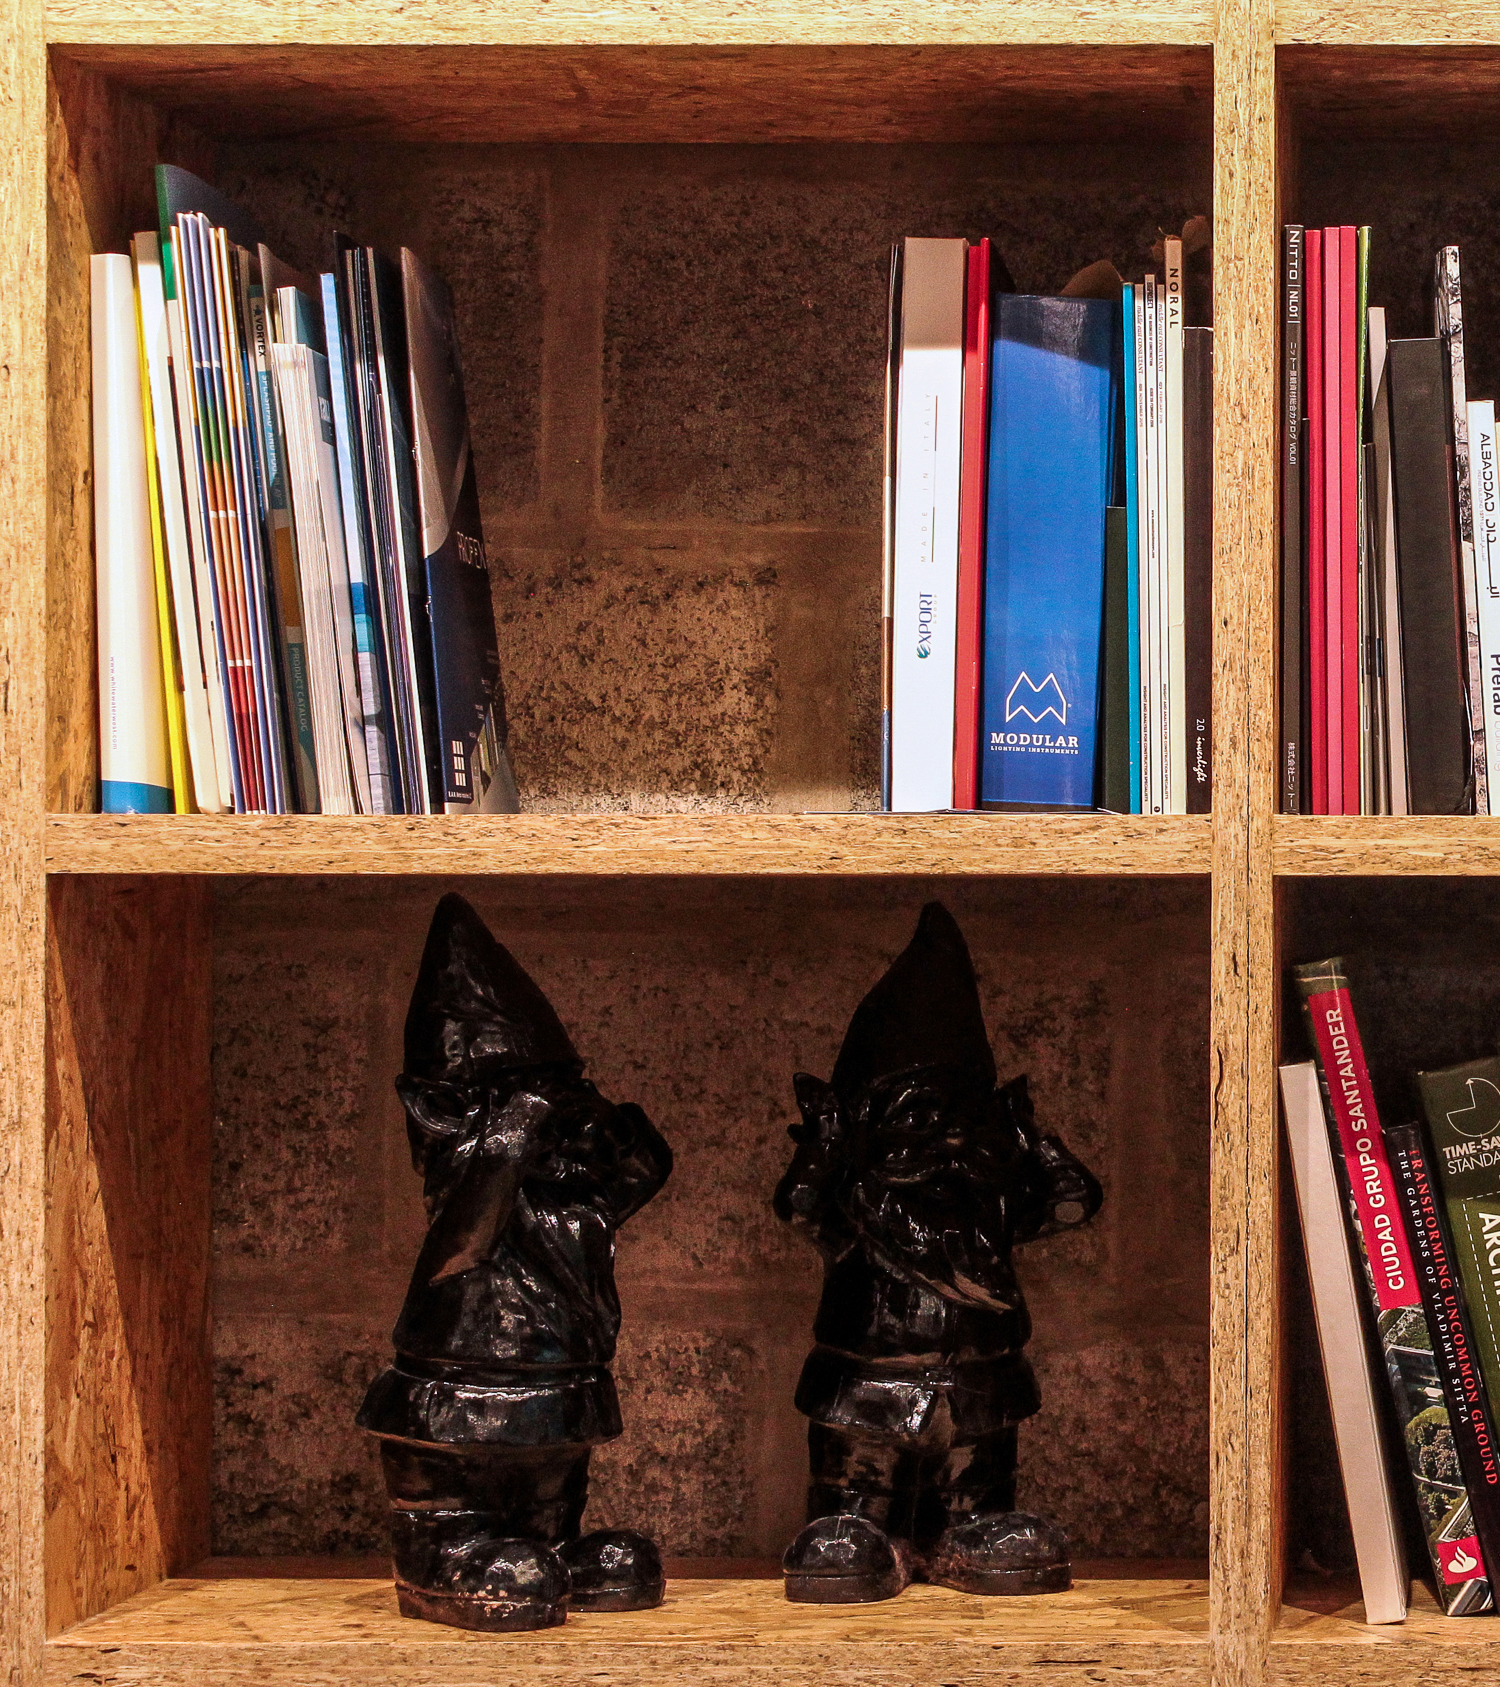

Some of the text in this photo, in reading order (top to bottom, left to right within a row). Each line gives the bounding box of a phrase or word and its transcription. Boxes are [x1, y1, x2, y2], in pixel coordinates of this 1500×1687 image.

[1169, 267, 1180, 330] NORAL
[1288, 229, 1301, 318] NITTO NL01
[254, 317, 267, 358] VORTEX
[920, 393, 931, 562] MADE IN ITALY
[1480, 432, 1496, 513] ALBADDAD
[290, 647, 309, 733] PRODUCT CATALOG
[1196, 718, 1206, 732] 2.0
[990, 732, 1079, 748] MODULAR
[990, 745, 1079, 755] LIGHTING INSTRUMENTS
[1287, 741, 1296, 807] 株式会社ニットー
[1325, 1007, 1405, 1291] CIUDAD GRUPO SANTANDER
[1397, 1150, 1469, 1424] THE GARDENS OF VLADIMIR SITTA
[1408, 1149, 1499, 1485] TRANSFORMING UNCOMMON GROUND
